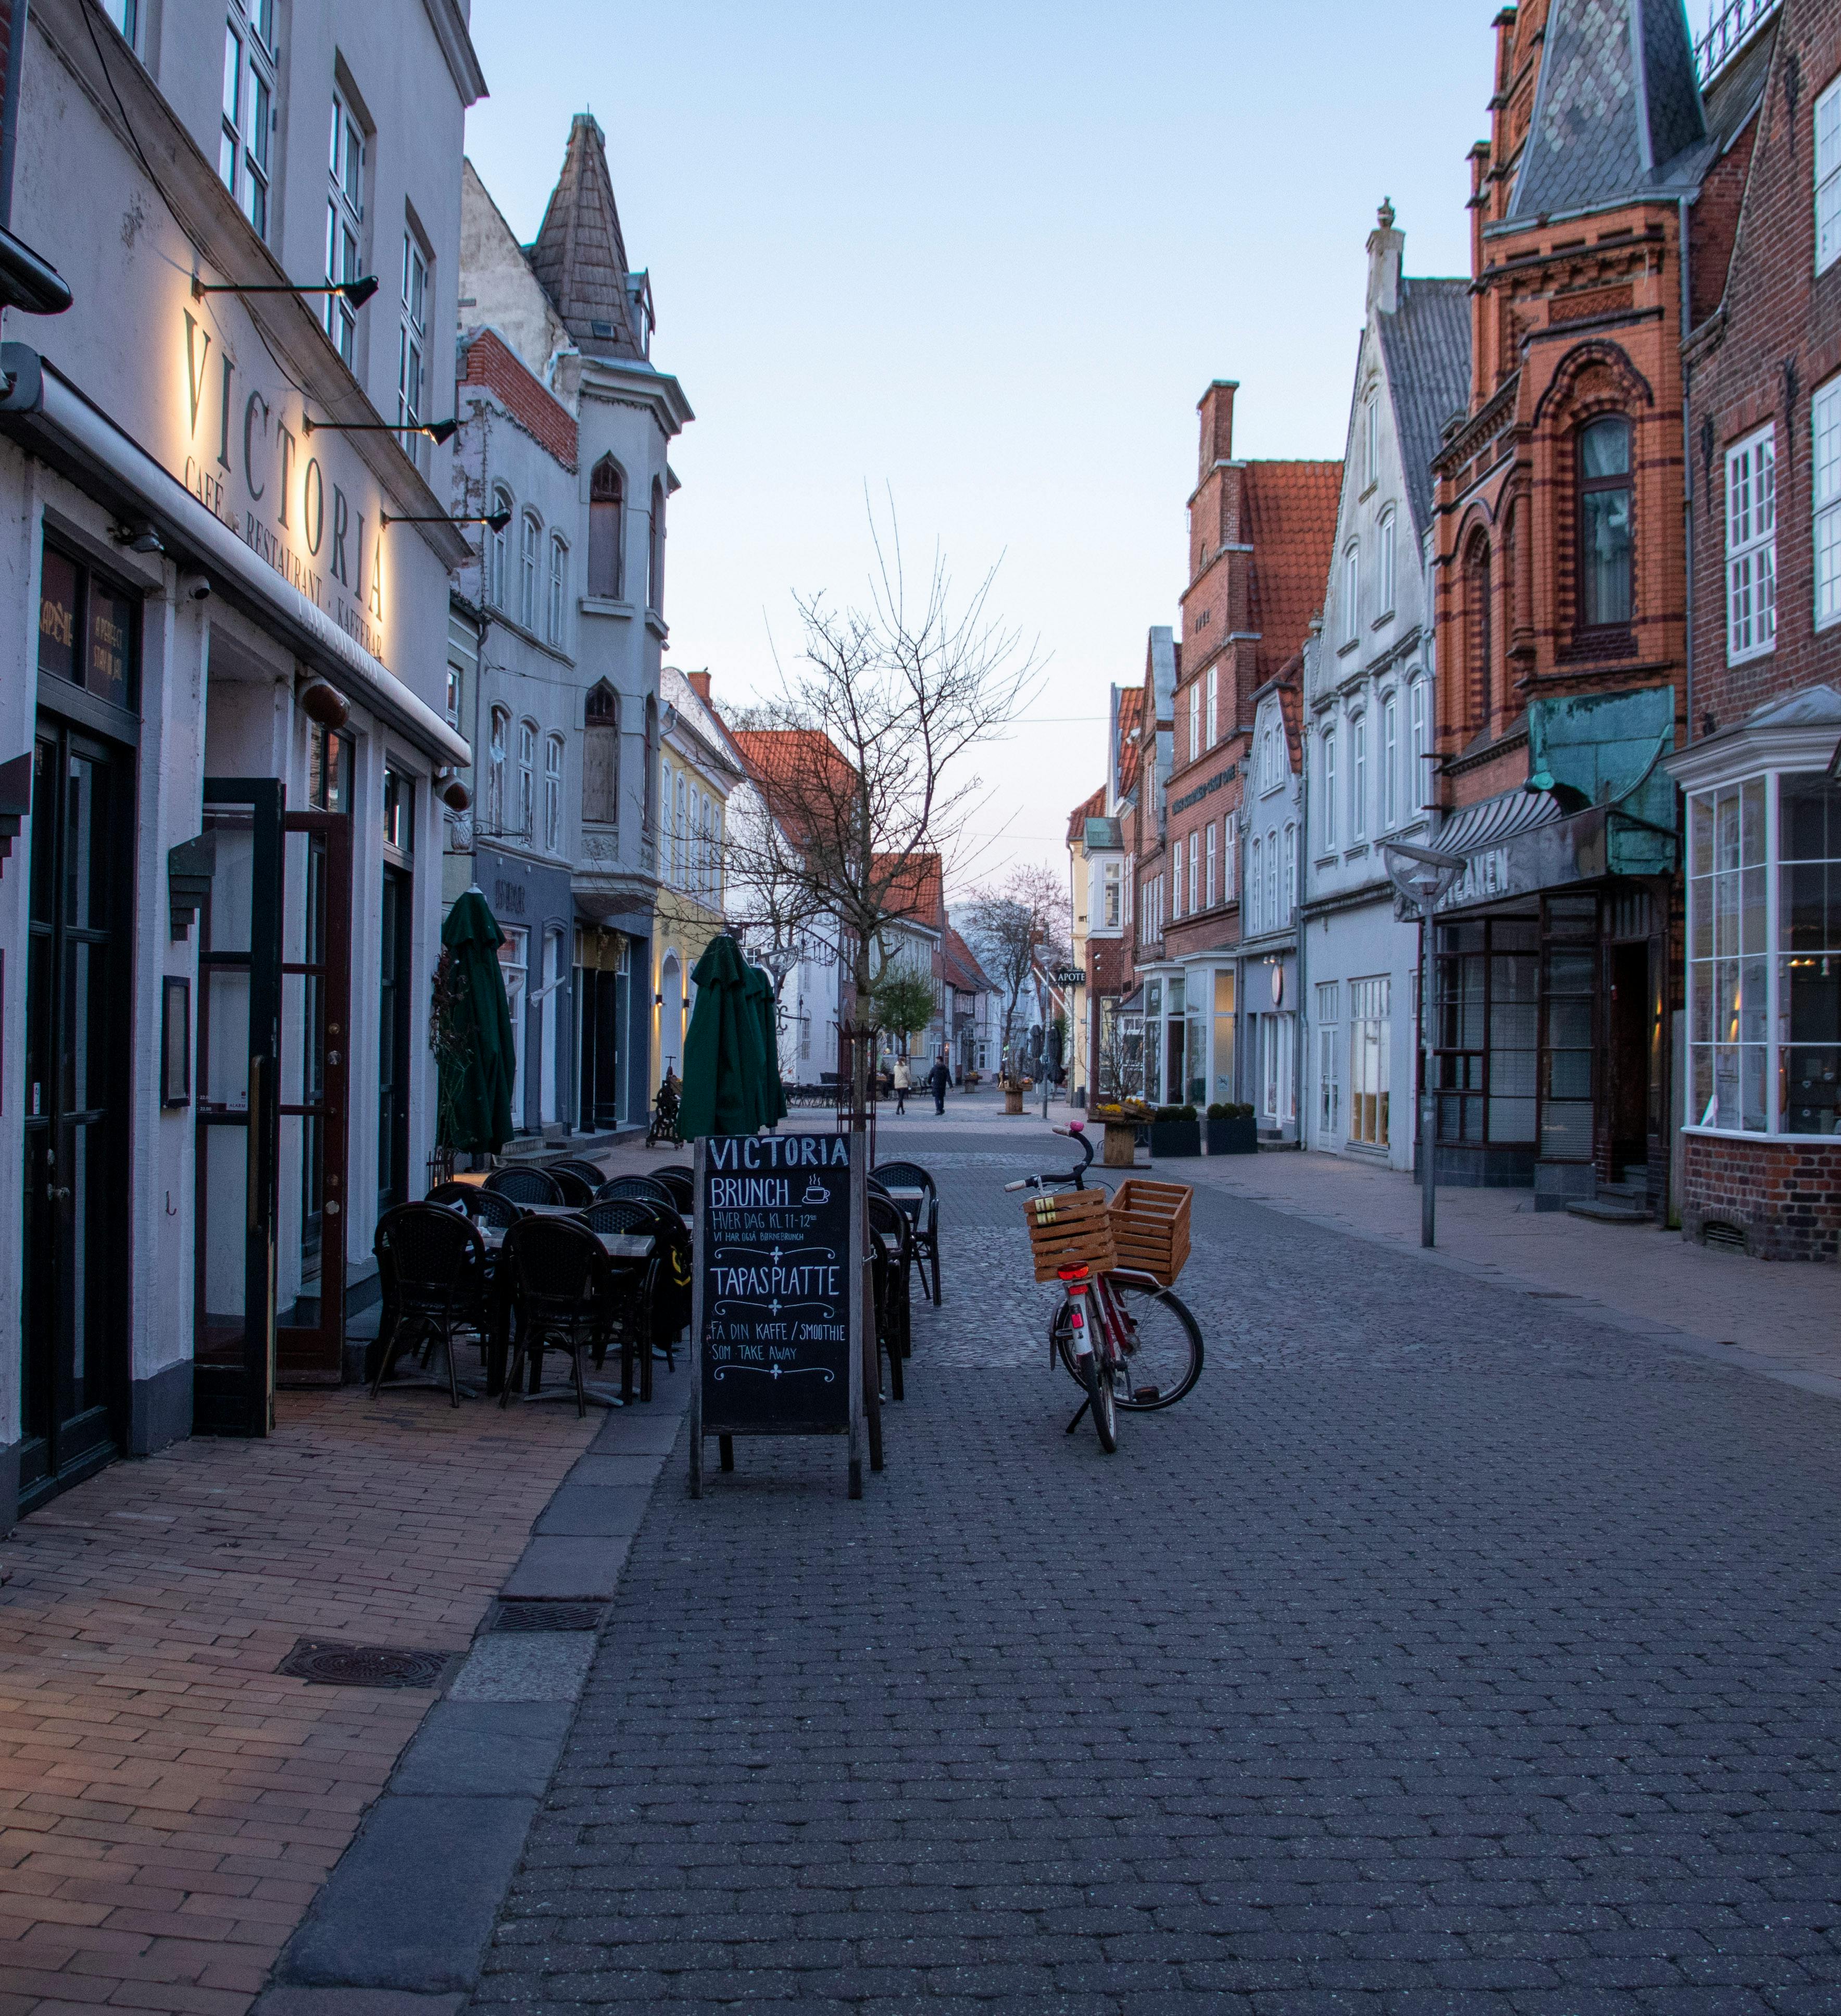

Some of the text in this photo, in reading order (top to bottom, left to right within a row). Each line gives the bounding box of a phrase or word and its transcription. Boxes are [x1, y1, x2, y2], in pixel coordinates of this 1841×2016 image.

[183, 306, 382, 623] VICTORIA
[185, 455, 382, 663] CAFÉ RESTAURANT KAFFEBAR
[709, 1137, 848, 1170] VICTORIA
[711, 1178, 788, 1207] BRUNCH
[712, 1211, 741, 1230] HVER
[744, 1213, 765, 1229] DAG
[770, 1213, 783, 1229] KL
[714, 1231, 804, 1242] VI HAR OGSÅ BØRNEBRUNCH
[710, 1266, 840, 1295] TAPASPLATTE
[711, 1321, 725, 1339] FÅ
[731, 1323, 749, 1339] DIN
[756, 1323, 787, 1340] KAFFE
[712, 1344, 797, 1360] SOM TAKE AWAY
